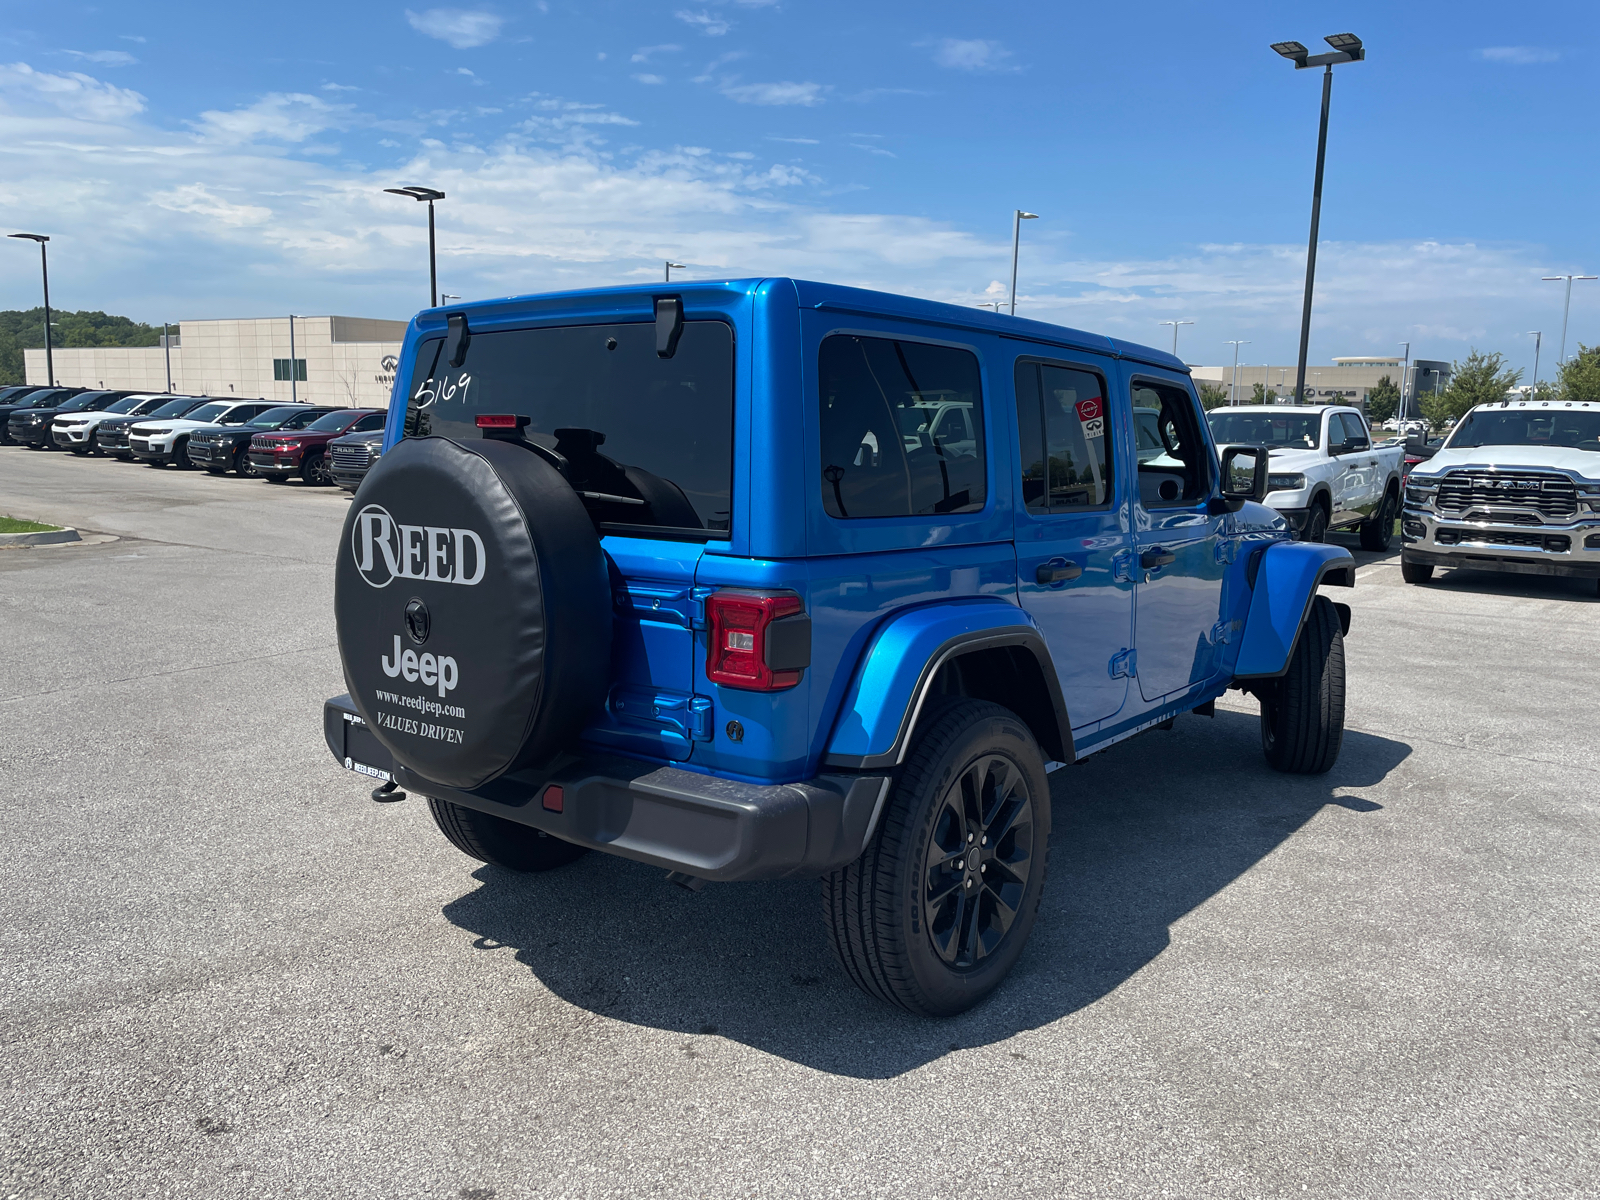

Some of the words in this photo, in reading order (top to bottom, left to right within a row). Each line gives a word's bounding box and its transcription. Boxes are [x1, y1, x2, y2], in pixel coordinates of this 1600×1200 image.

[414, 372, 472, 409] 5169
[1473, 479, 1540, 490] RAM
[353, 505, 486, 587] REED
[381, 634, 459, 698] Jeep
[375, 689, 466, 719] www.reedjeep.com
[377, 711, 418, 735] VALUES
[419, 722, 464, 744] DRIVEN
